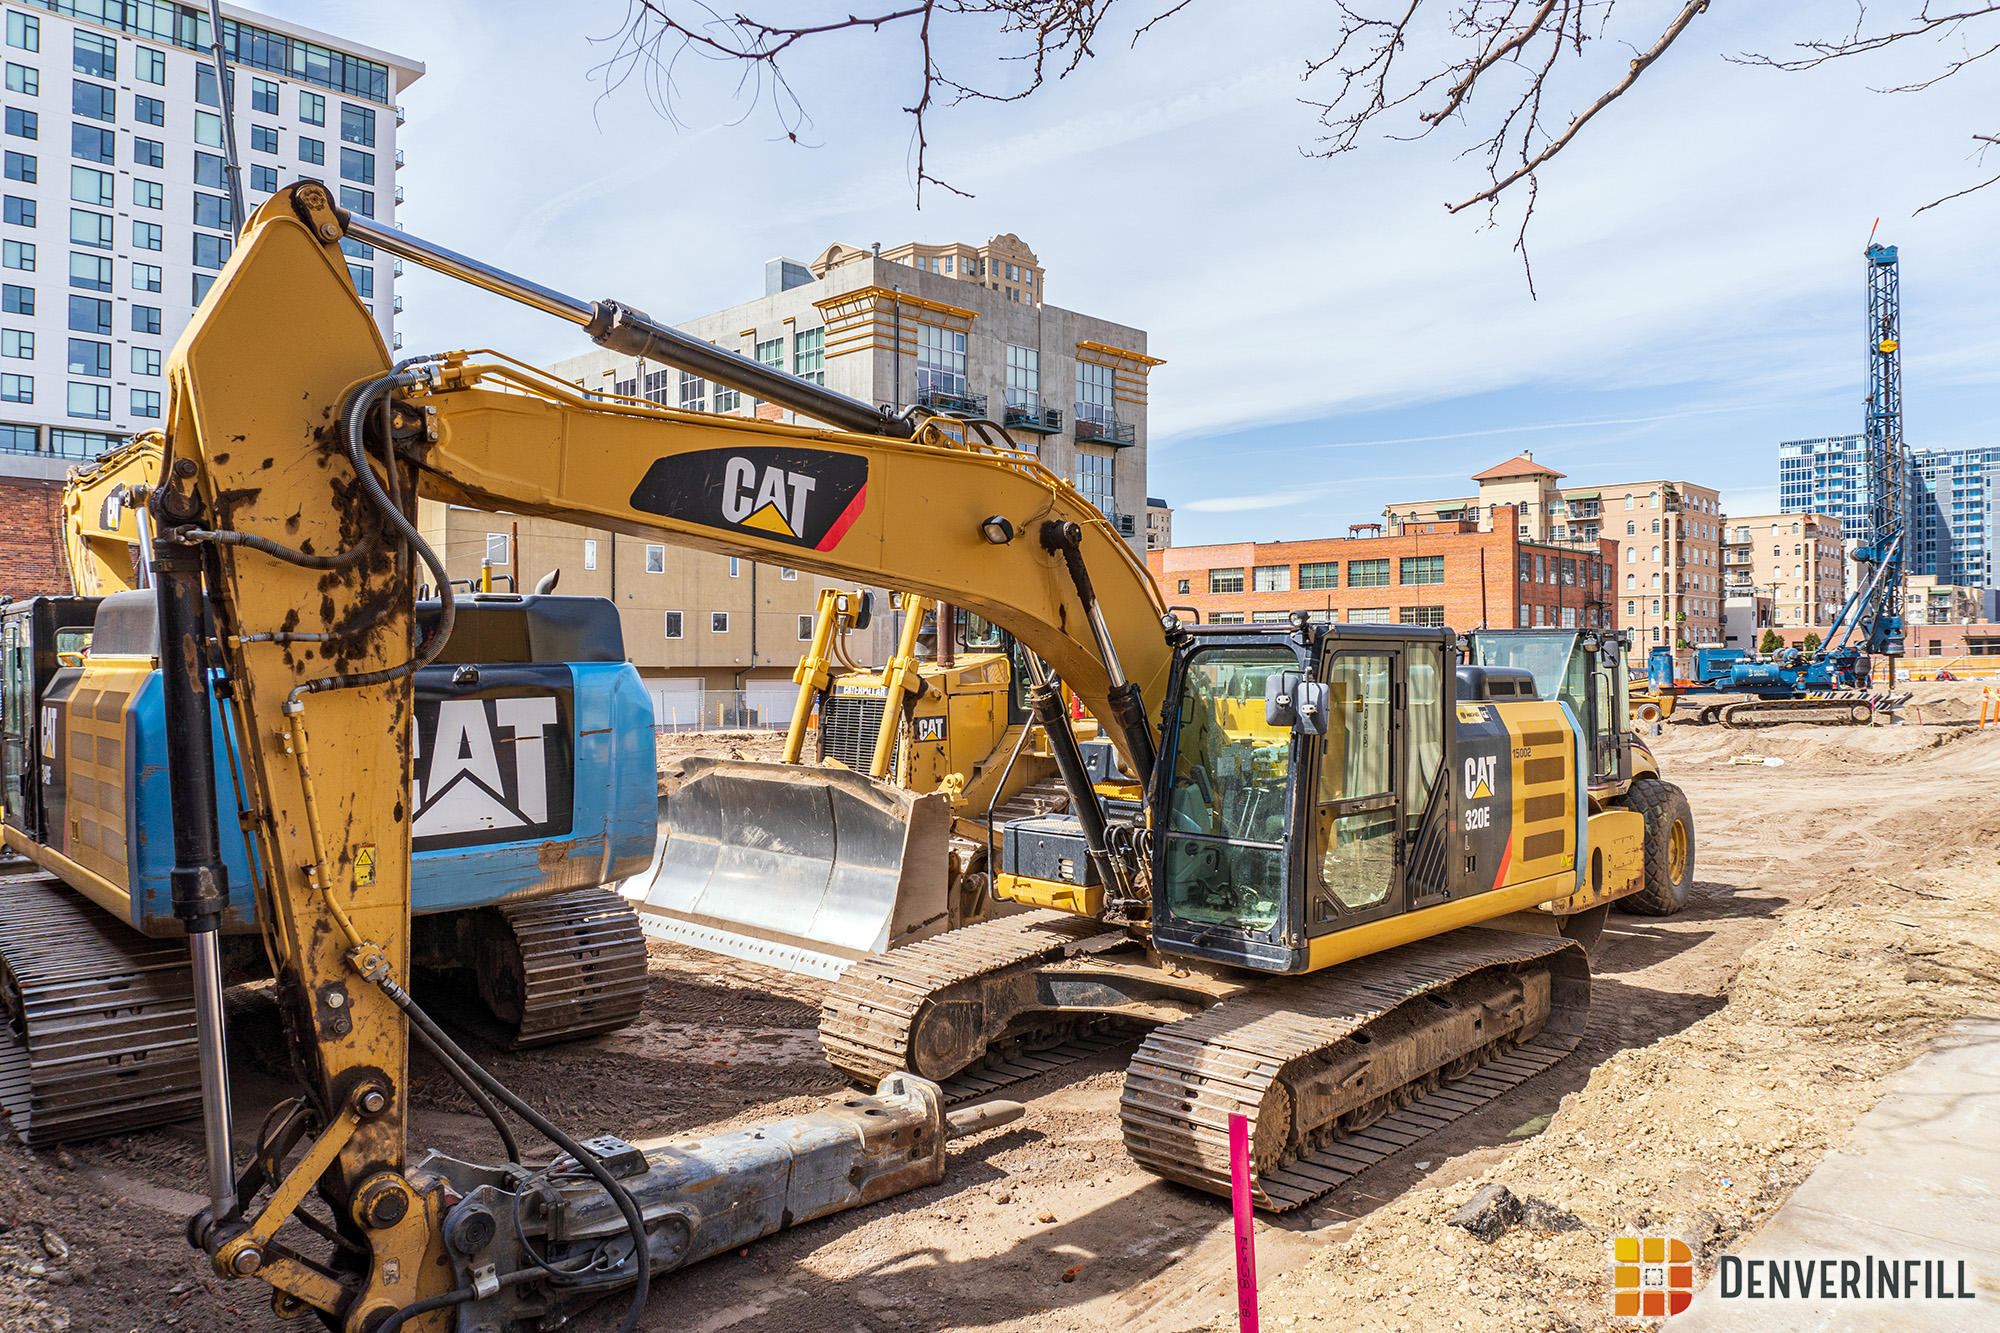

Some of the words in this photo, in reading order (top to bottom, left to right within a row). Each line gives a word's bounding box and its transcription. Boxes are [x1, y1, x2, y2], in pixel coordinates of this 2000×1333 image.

[721, 456, 816, 539] CAT
[843, 685, 886, 697] CATERPILLAR
[42, 705, 58, 759] CAT
[919, 718, 944, 741] CAT
[412, 697, 557, 825] AT
[1512, 747, 1532, 758] 15002
[1464, 755, 1497, 800] CAT
[1465, 806, 1490, 831] 320E
